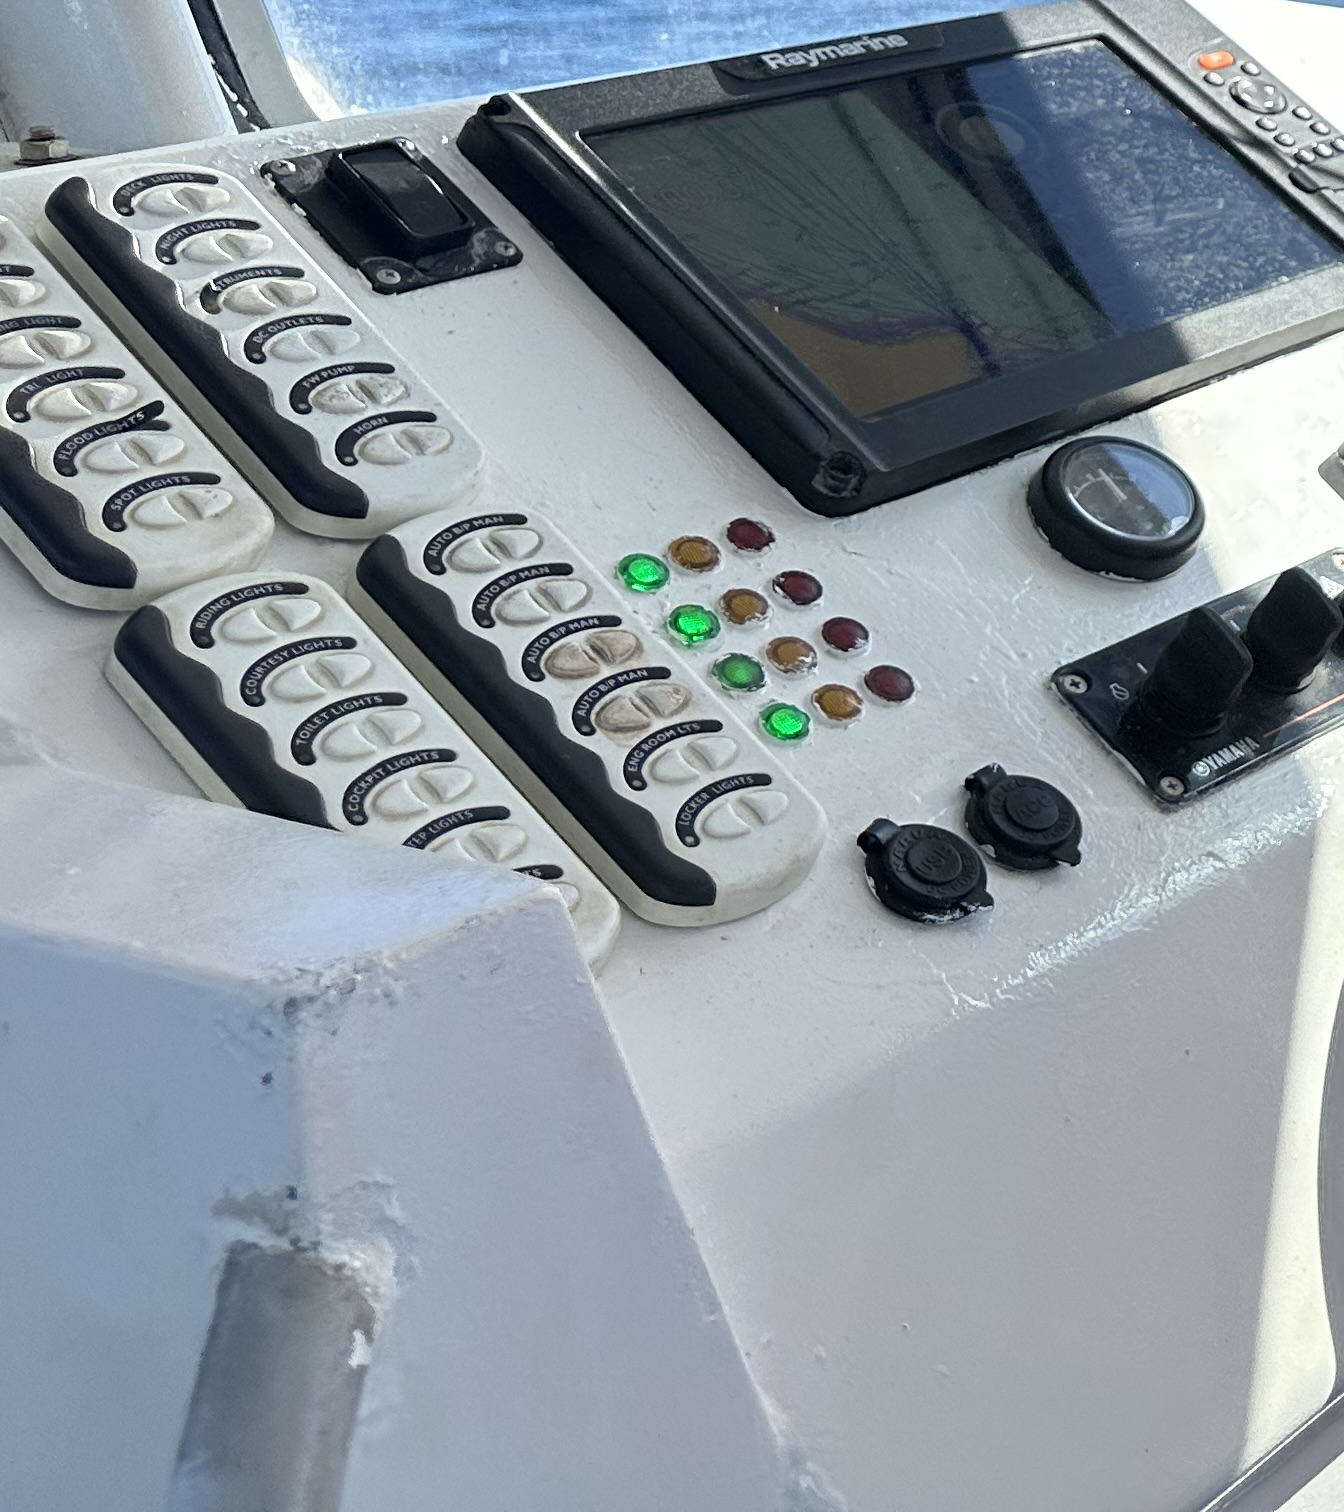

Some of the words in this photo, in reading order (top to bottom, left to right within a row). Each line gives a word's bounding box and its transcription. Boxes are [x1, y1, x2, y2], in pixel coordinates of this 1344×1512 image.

[761, 33, 908, 69] Raymarine
[120, 181, 147, 196] DECK
[150, 173, 195, 184] LIGHTS
[160, 228, 191, 250] NIGHT
[190, 219, 237, 233] LIGHTS
[252, 330, 269, 344] DC
[267, 316, 324, 332] OUTLETS
[45, 369, 84, 384] LIGHT
[302, 374, 322, 388] FW
[322, 365, 355, 379] PUMP
[58, 432, 93, 461] FLOOD
[94, 410, 145, 437] LIGHTS
[353, 416, 389, 435] HORN
[111, 489, 138, 511] SPOT
[139, 475, 191, 491] LIGHTS
[428, 531, 453, 557] AUTO
[452, 523, 471, 535] B/P
[473, 515, 504, 528] MAN
[195, 597, 232, 629] RIDING
[230, 583, 284, 602] LIGHTS
[476, 584, 501, 611] AUTO
[499, 575, 518, 587] B/P
[519, 566, 550, 579] MAN
[527, 637, 550, 664] AUTO
[548, 626, 567, 640] B/P
[568, 617, 600, 631] MAN
[245, 650, 293, 696] COURTESY
[291, 639, 343, 655] LIGHTS
[576, 689, 600, 717] AUTO
[598, 678, 616, 692] B/P
[617, 669, 649, 683] MAN
[295, 713, 331, 747] TOILET
[330, 694, 384, 716] LIGHTS
[627, 749, 645, 773] ENG
[641, 729, 678, 752] ROOM
[677, 722, 701, 735] LTS
[1201, 736, 1260, 770] YAMAHA
[347, 769, 386, 812] COCKPIT
[386, 751, 440, 772] LIGHTS
[678, 791, 711, 826] LOCKER
[711, 776, 755, 794] LIGHTS
[428, 809, 474, 834] LIGHTS
[915, 844, 954, 876] USB
